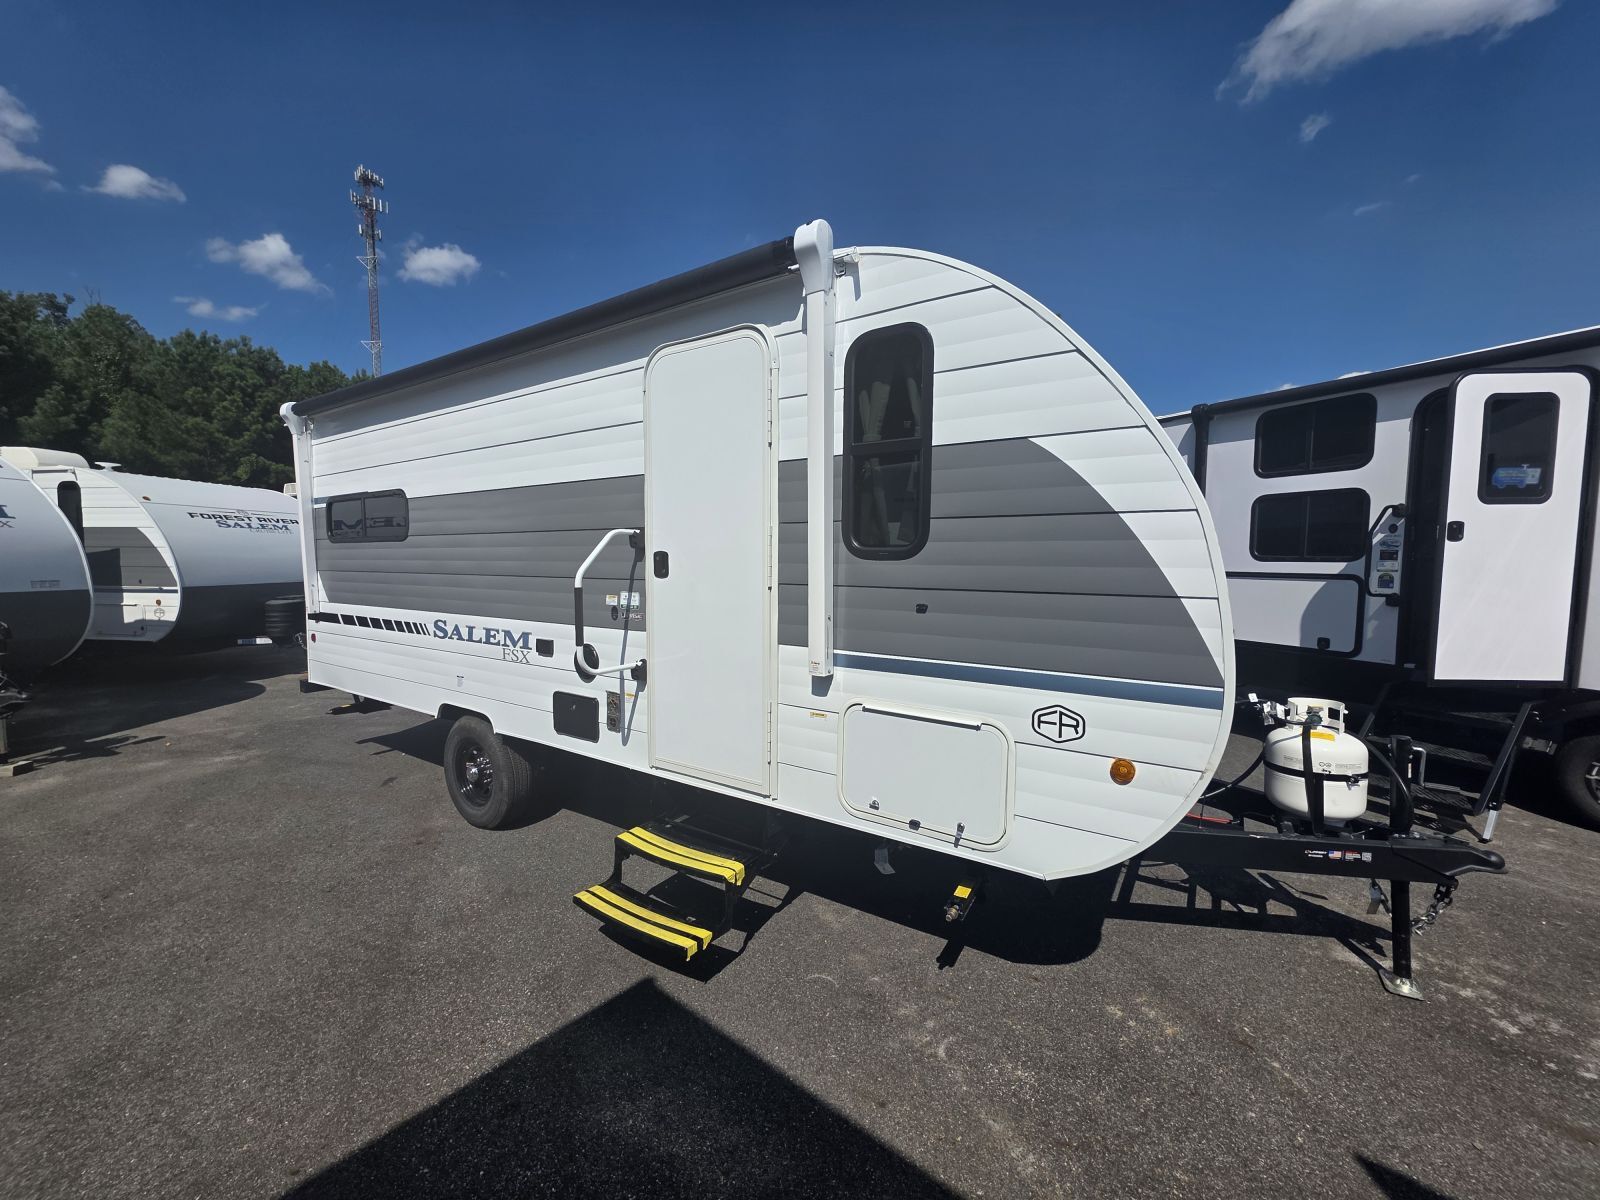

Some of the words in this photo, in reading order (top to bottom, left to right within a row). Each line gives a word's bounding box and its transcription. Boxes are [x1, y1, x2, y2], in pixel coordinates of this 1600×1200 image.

[187, 512, 252, 522] FOREST
[255, 516, 299, 525] RIVER
[216, 519, 291, 531] SALEM
[433, 619, 532, 650] SALEM
[502, 647, 531, 664] FSX
[1037, 710, 1080, 739] FR
